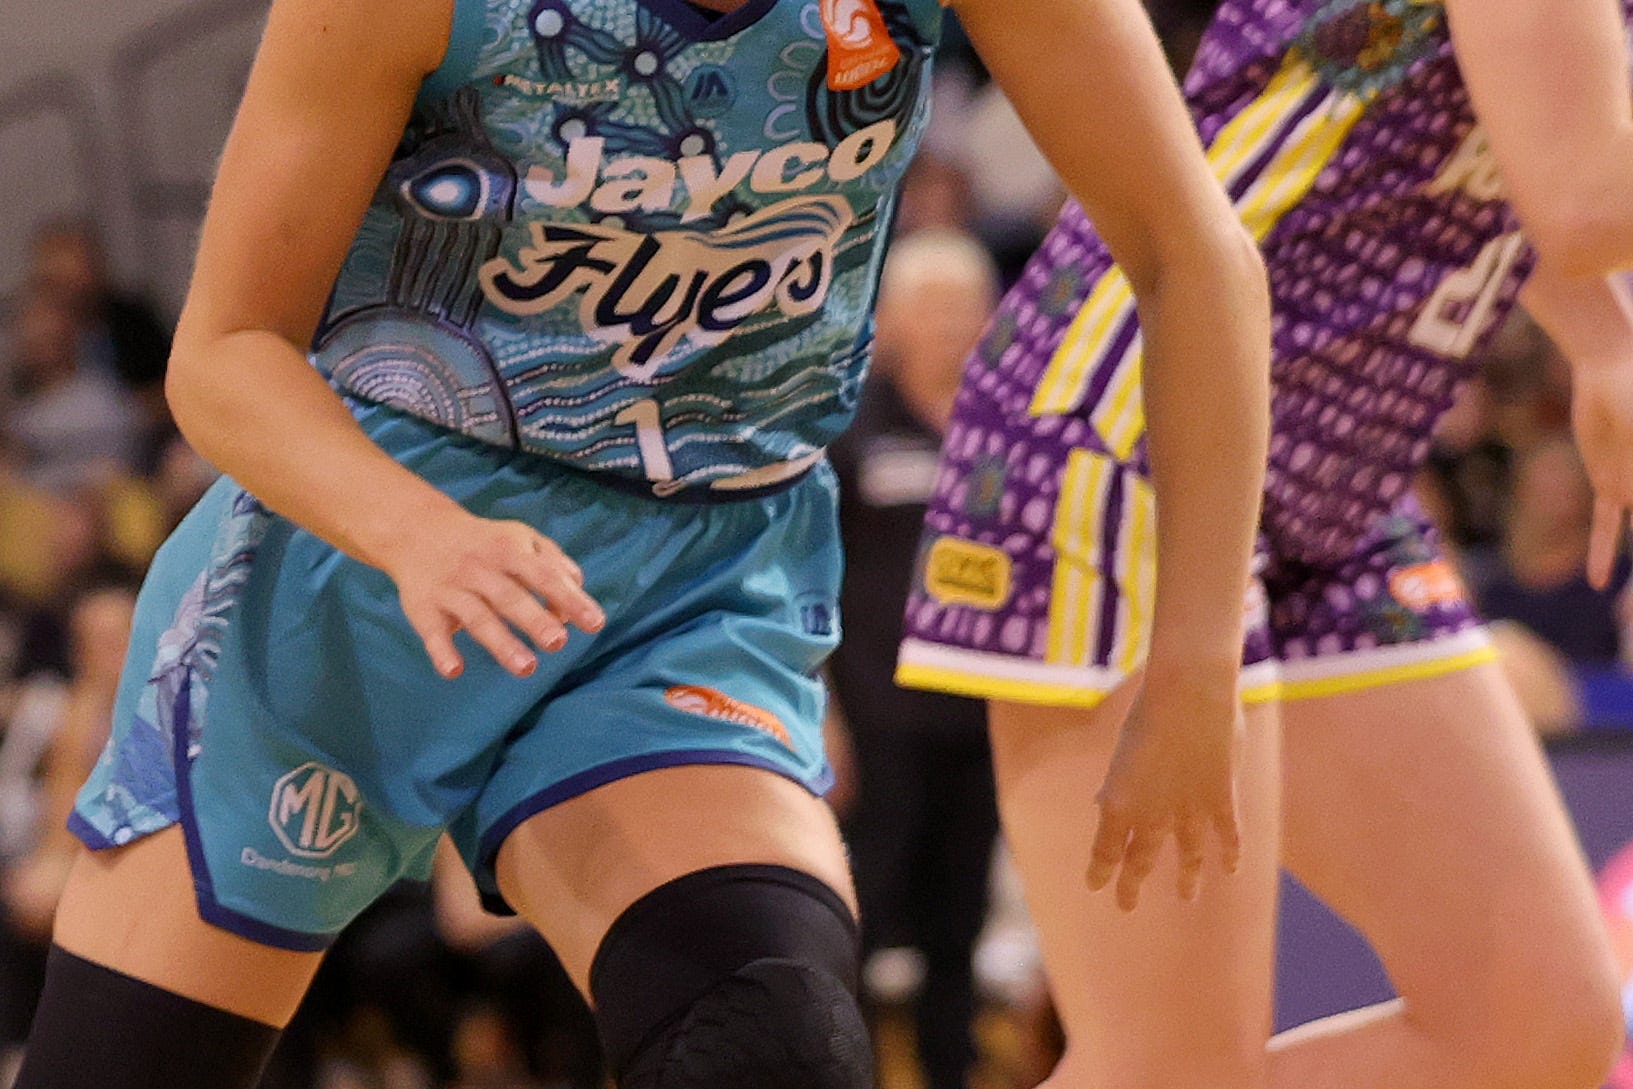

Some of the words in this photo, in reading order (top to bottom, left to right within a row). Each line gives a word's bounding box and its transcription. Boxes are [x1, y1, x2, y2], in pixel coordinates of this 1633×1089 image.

[523, 119, 896, 223] Jayco
[615, 398, 674, 484] 1
[279, 770, 357, 848] MG
